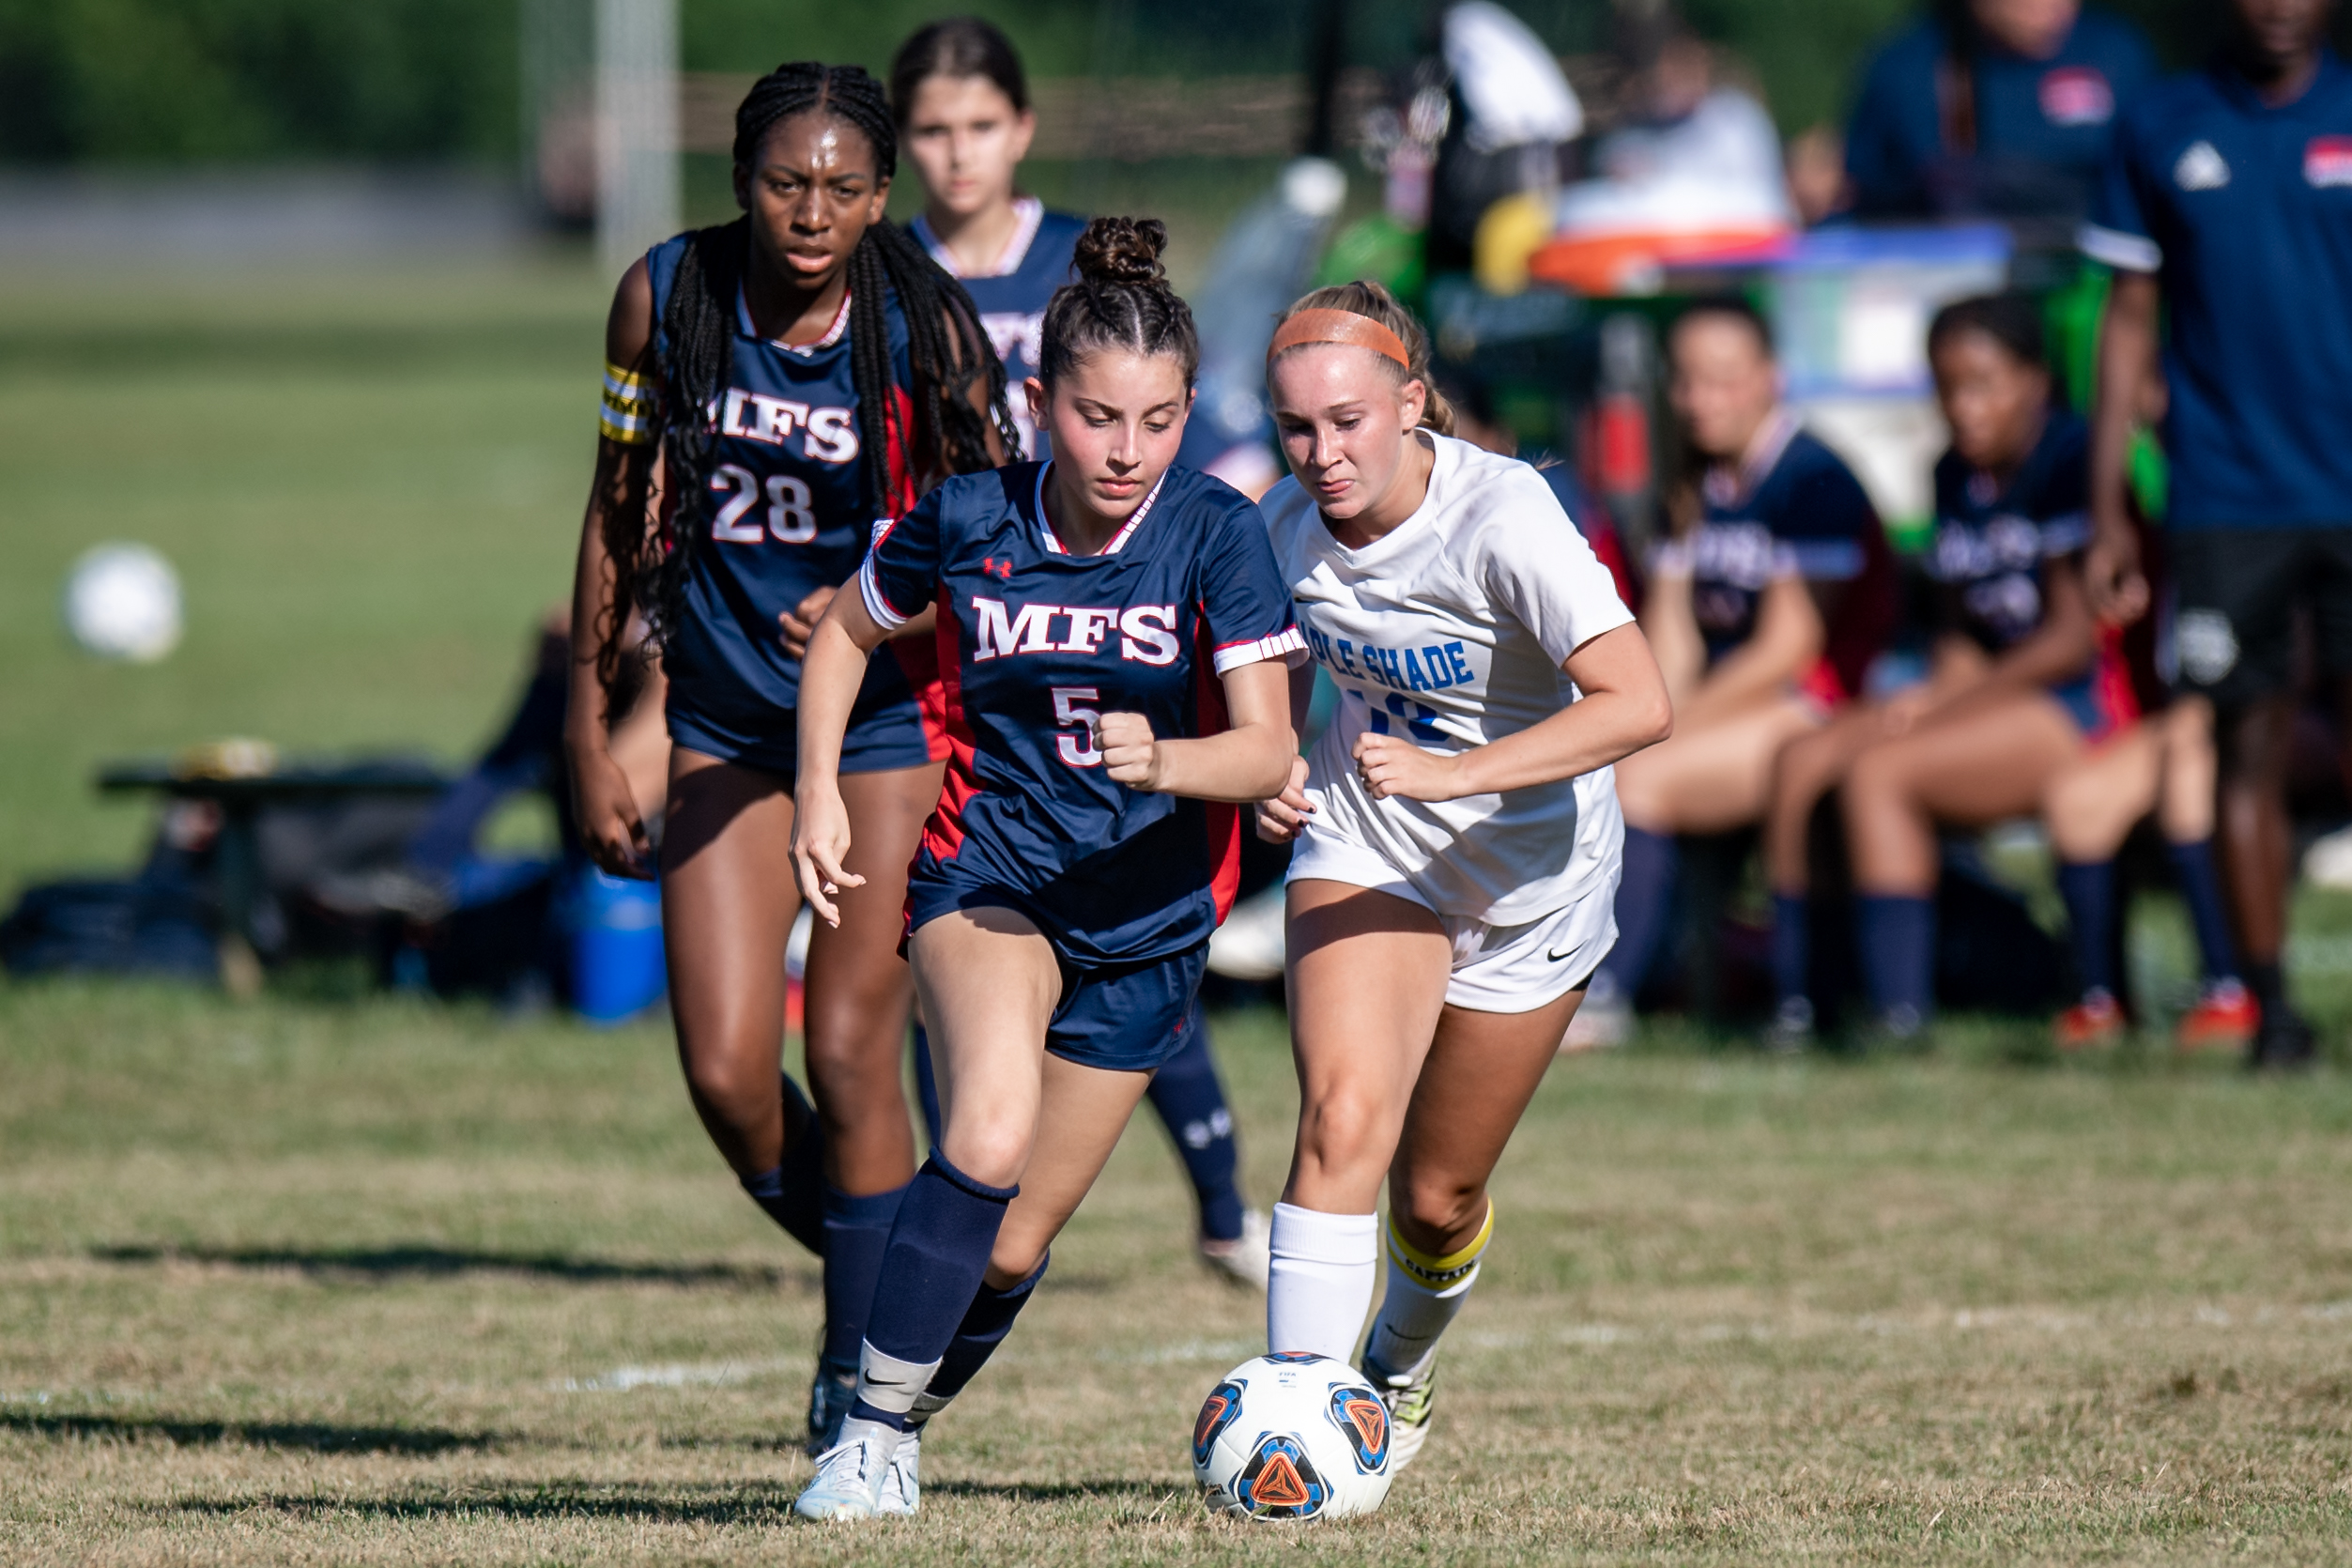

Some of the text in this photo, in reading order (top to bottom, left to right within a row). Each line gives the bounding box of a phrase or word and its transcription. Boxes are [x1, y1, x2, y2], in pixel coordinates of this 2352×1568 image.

[711, 463, 818, 545] 28
[972, 595, 1180, 667] MFS
[1362, 640, 1475, 692] SHADE
[1051, 686, 1104, 768] 5
